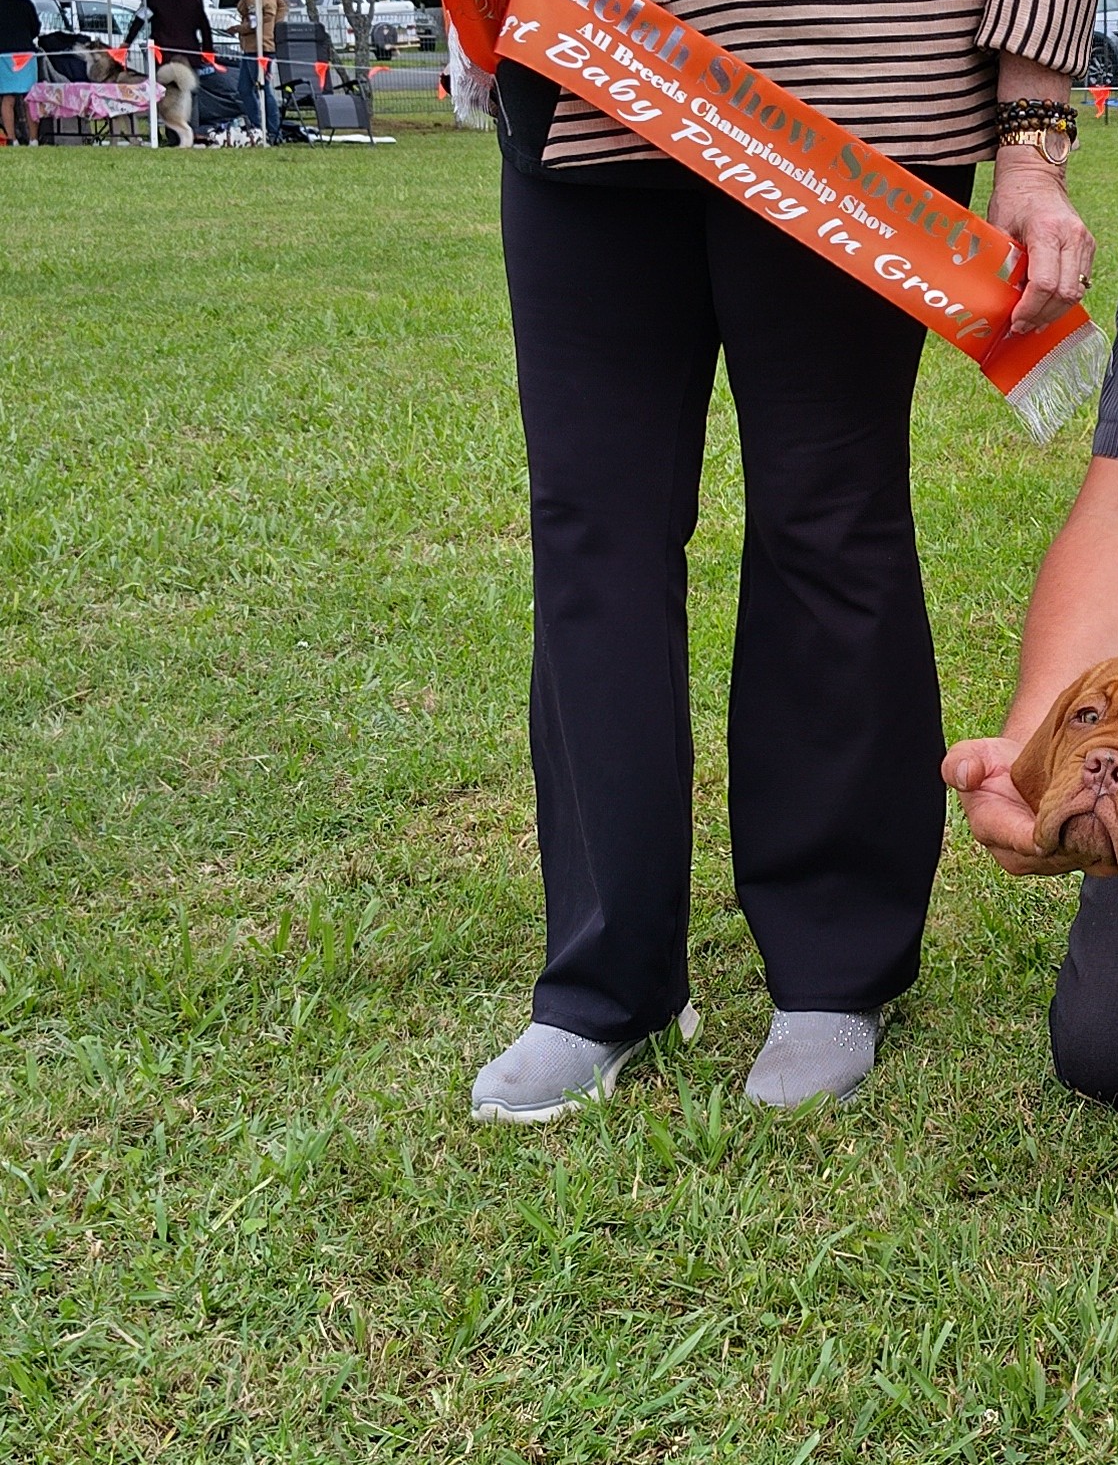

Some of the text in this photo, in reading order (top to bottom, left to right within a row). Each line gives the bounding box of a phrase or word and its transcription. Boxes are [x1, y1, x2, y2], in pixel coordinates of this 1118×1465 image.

[545, 33, 663, 122] Baby
[671, 118, 809, 220] Puppy
[817, 218, 862, 255] In
[874, 254, 992, 339] Group
[576, 23, 898, 238] All Breeds Championship Show
[697, 56, 826, 153] Show
[829, 143, 991, 265] Society
